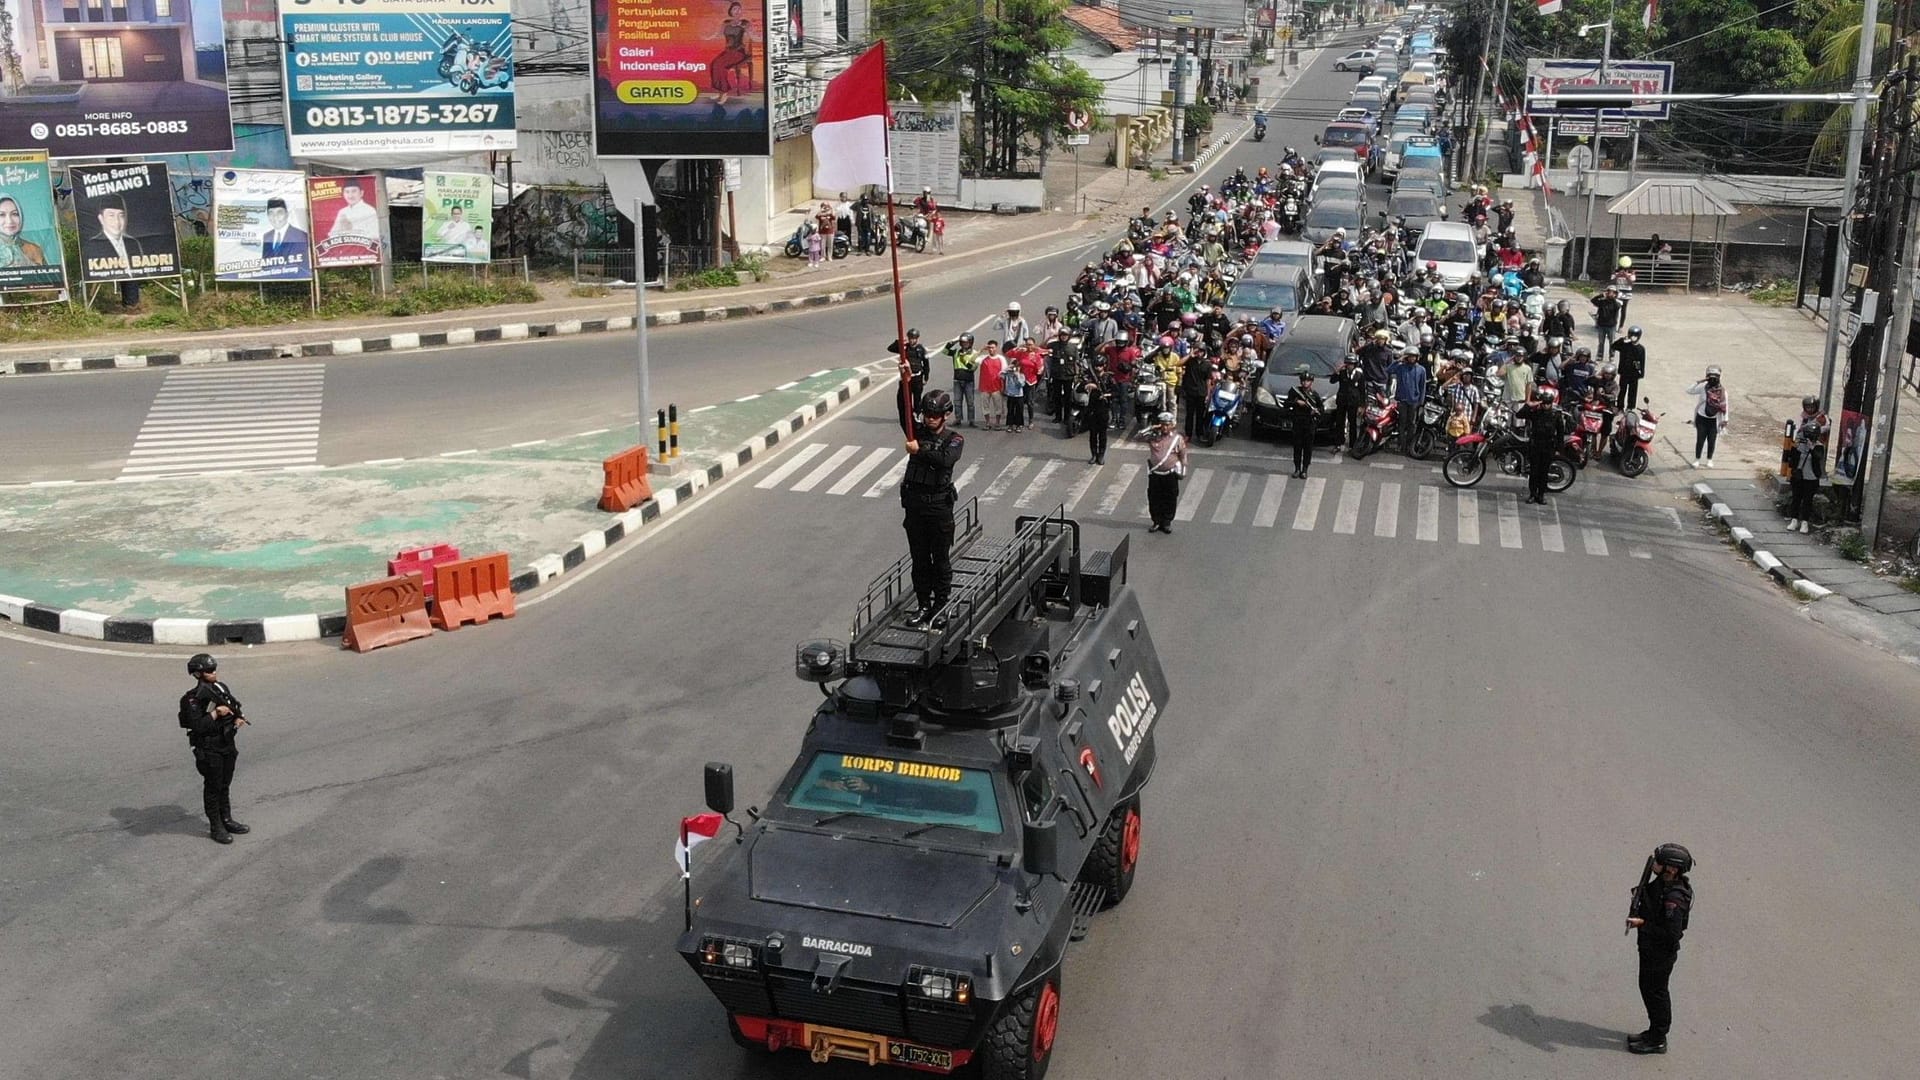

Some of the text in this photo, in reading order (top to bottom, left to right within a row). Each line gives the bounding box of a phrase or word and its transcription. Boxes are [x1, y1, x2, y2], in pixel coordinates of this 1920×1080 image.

[618, 7, 688, 17] Pertunjukan &
[294, 23, 380, 32] PREMIUM CLUSTER WITH
[618, 19, 679, 29] Penggunaan
[294, 32, 423, 43] SMART HOME SYSTEM & CLUB HOUSE
[618, 31, 670, 39] Fasilitas di
[311, 52, 361, 62] 5 MENIT
[379, 51, 434, 61] 10 MENIT
[619, 46, 654, 57] Galeri
[620, 61, 706, 72] Indonesia Kaya
[314, 74, 382, 83] Marketing Gallery
[630, 86, 684, 98] GRATIS
[84, 111, 133, 121] MORE INFO
[306, 104, 499, 127] 0813-1875-3267
[55, 120, 188, 137] 0851-8685-0883
[301, 136, 434, 148] www.royalsindangheula.co.id
[83, 165, 148, 186] Kota Serang
[86, 176, 143, 198] MENANG
[442, 198, 474, 209] PKB
[218, 230, 257, 238] Walikota
[88, 253, 174, 270] KANG BADRI
[1107, 671, 1151, 751] POLISI
[1123, 701, 1158, 765] KORPS BRIMOB
[841, 755, 961, 782] KORPS BRIMOB
[802, 936, 873, 957] BARRACUDA
